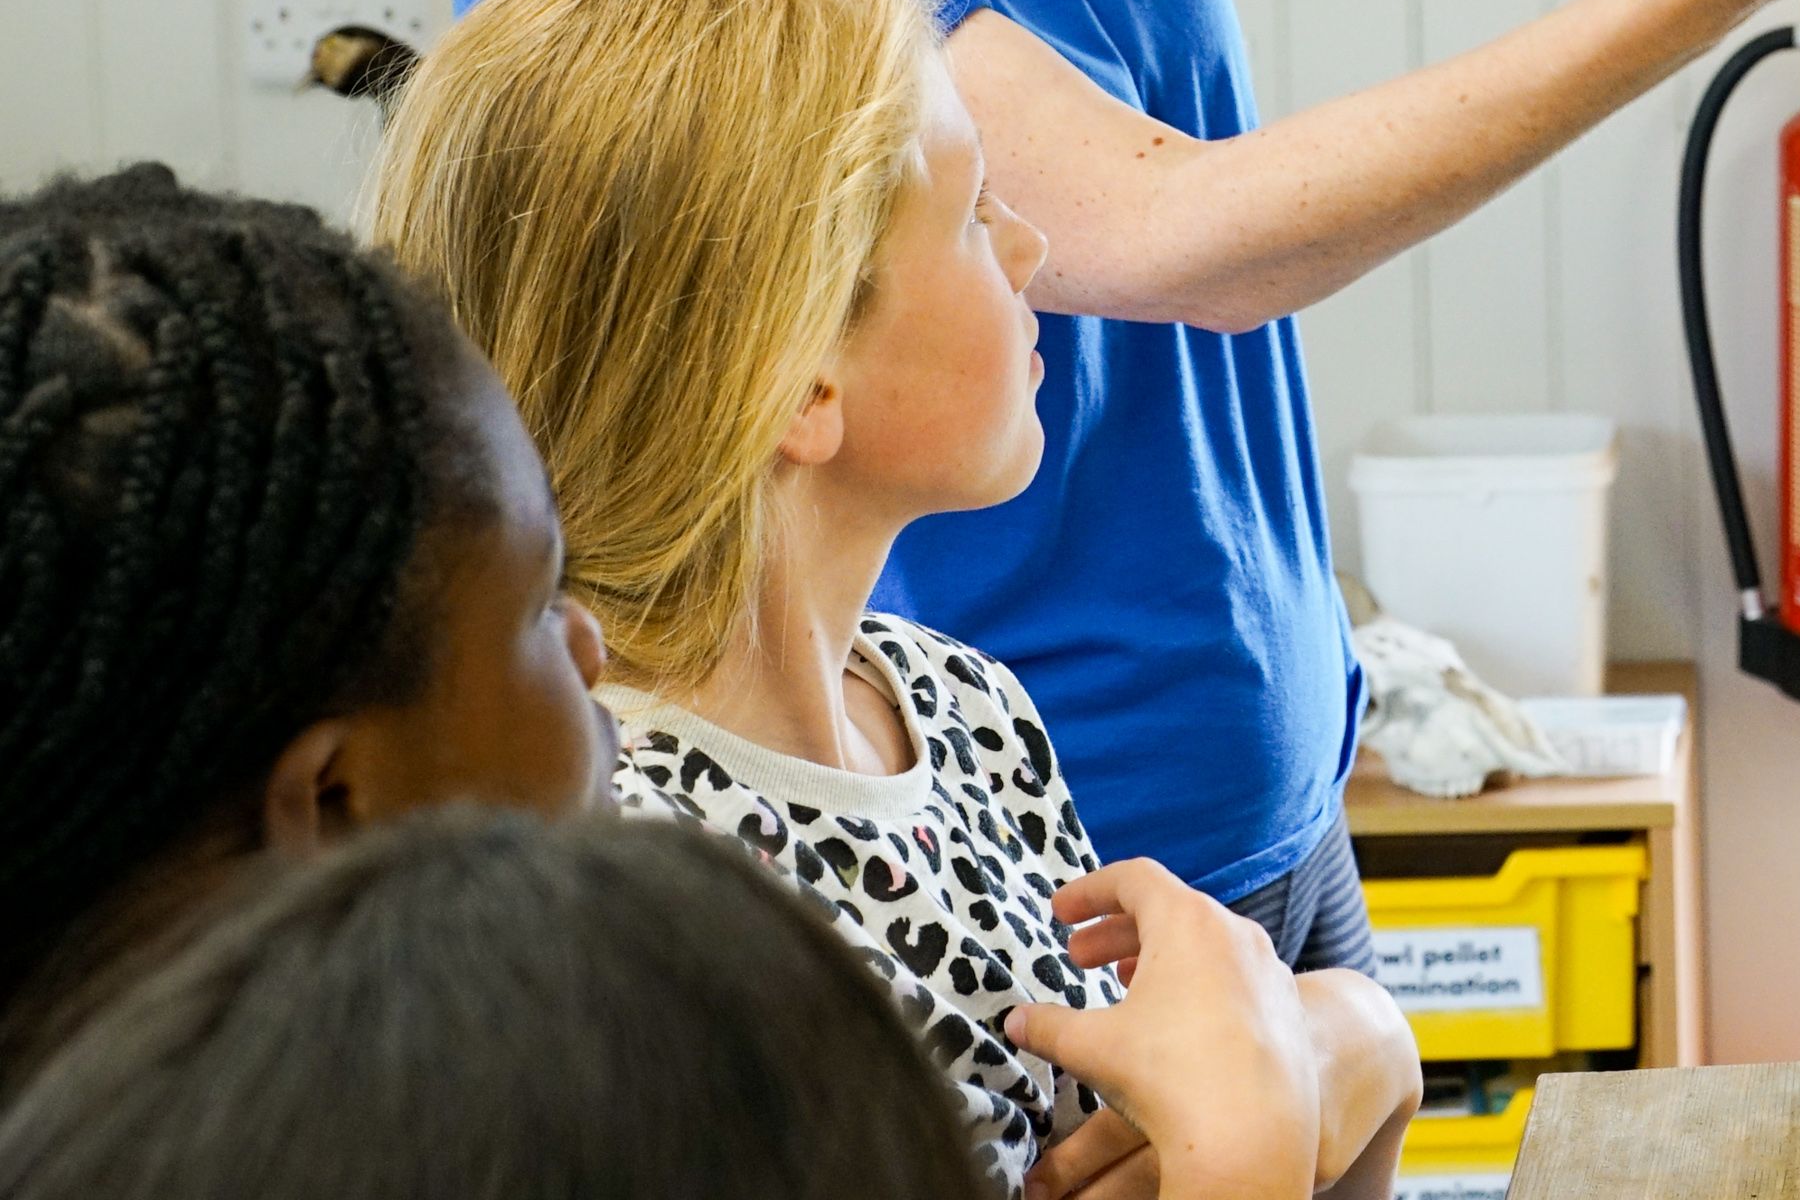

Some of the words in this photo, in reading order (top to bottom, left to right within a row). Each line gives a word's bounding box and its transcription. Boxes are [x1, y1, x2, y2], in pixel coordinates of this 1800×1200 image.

[1376, 943, 1413, 966] wl
[1423, 942, 1501, 970] pellet
[1382, 972, 1520, 996] amination
